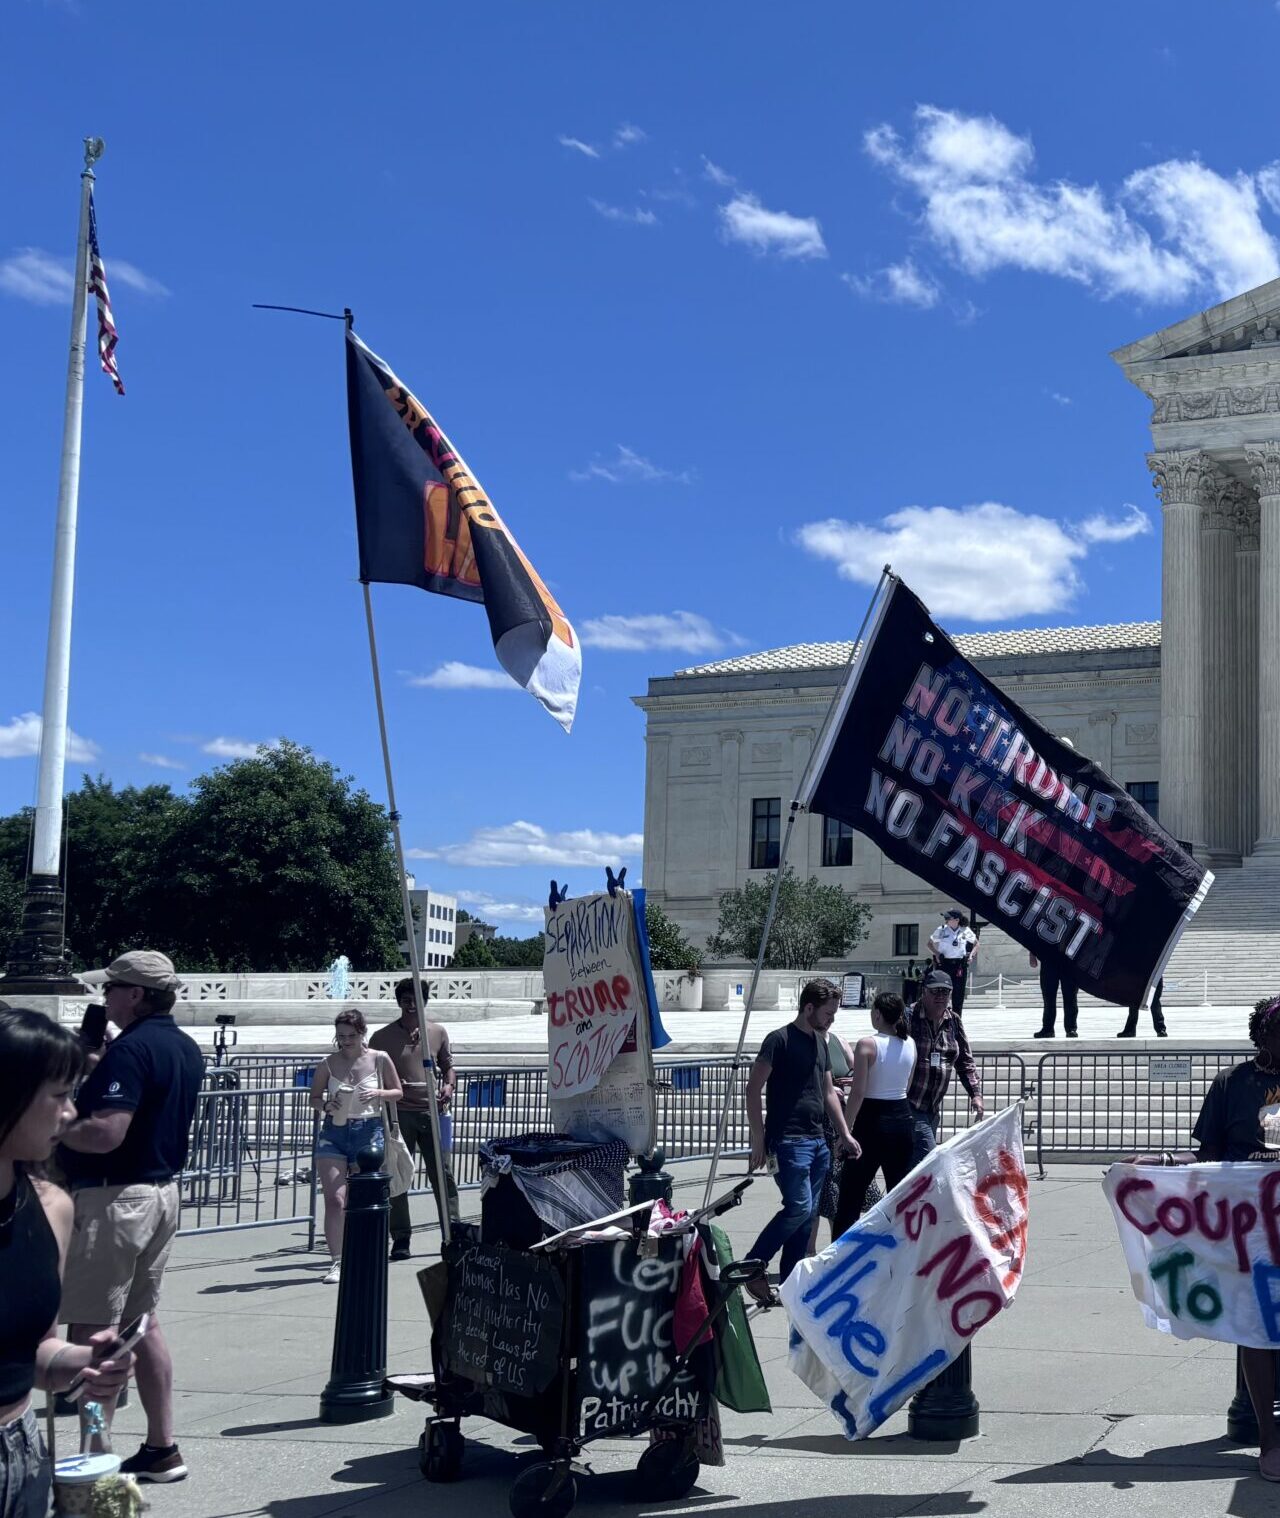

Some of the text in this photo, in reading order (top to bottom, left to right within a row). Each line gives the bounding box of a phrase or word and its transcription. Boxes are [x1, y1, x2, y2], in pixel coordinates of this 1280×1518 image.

[878, 714, 945, 786] NO
[903, 662, 1117, 832] NO TRUMP
[863, 768, 1104, 960] NO FASCIST
[546, 897, 625, 968] SEPARATION
[580, 1387, 700, 1437] Patrirchy
